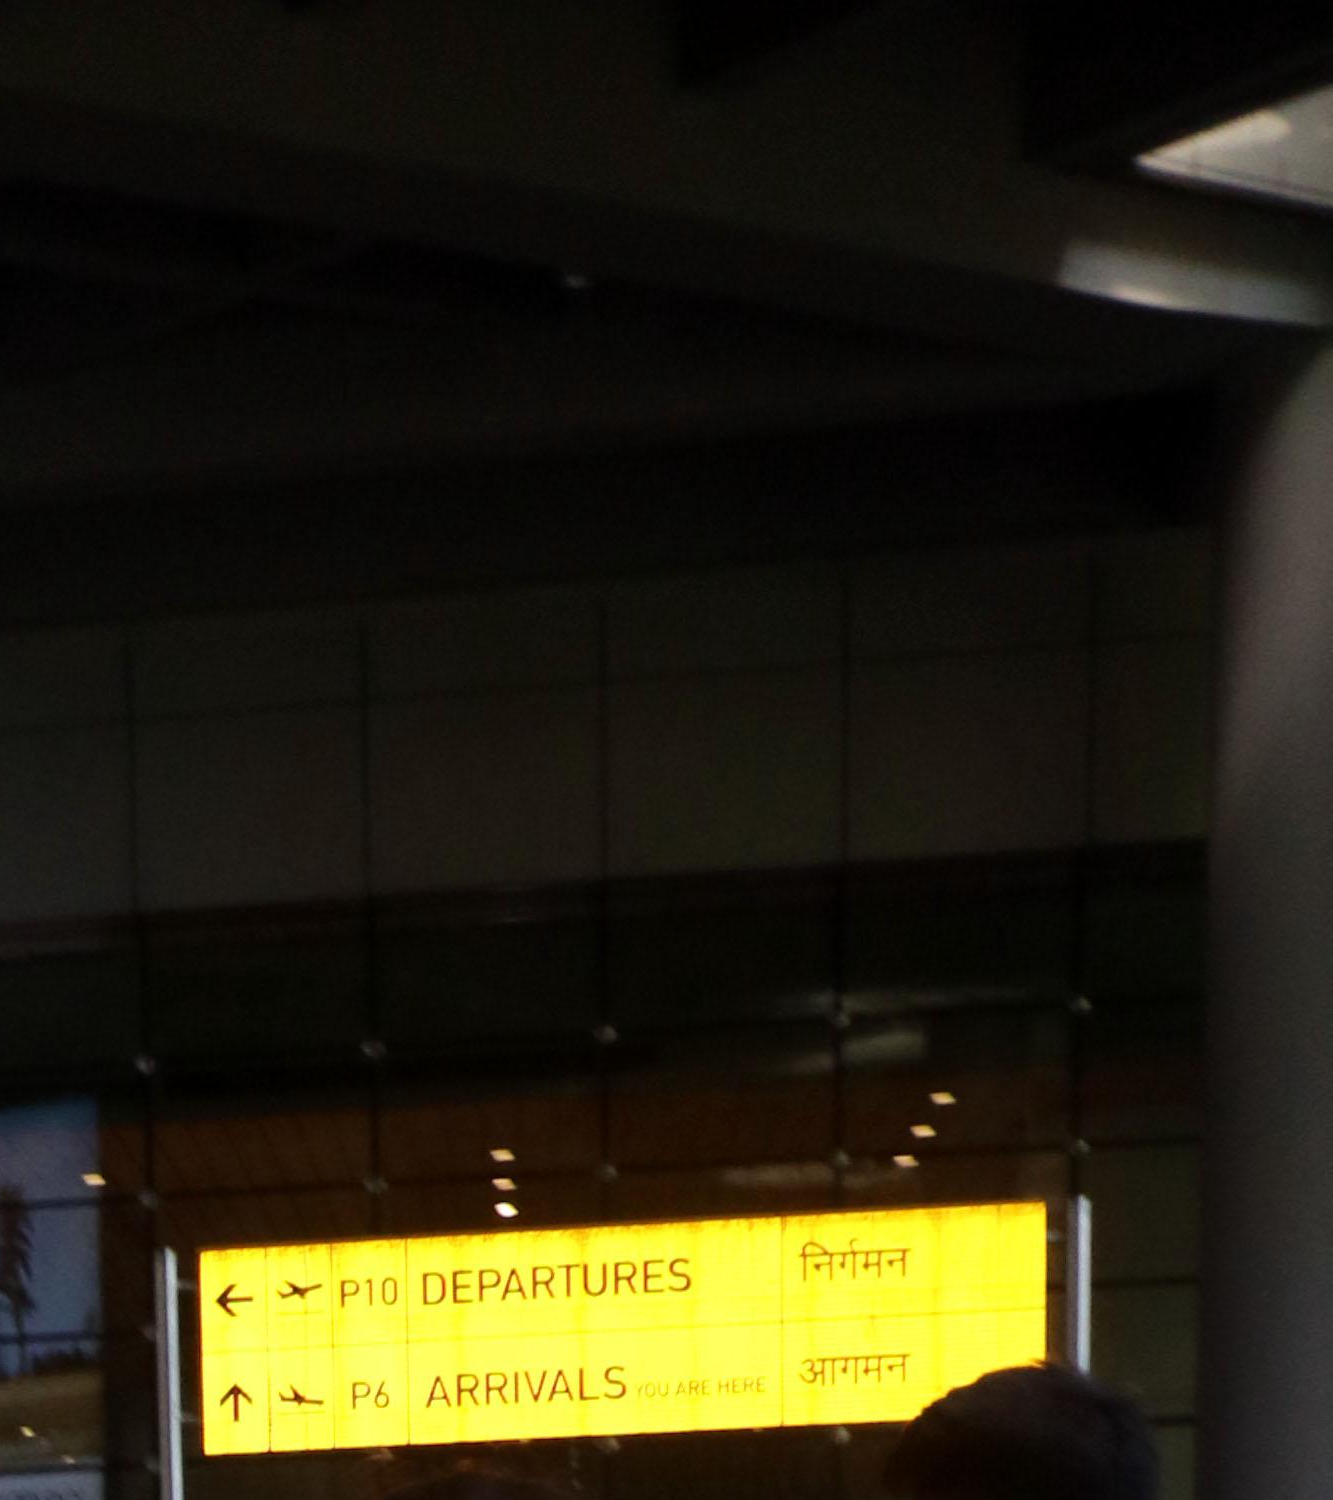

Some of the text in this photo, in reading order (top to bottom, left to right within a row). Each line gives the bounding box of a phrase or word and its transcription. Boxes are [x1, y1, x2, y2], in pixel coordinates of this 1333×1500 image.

[339, 1257, 694, 1309] P10 DEPARTURES
[798, 1238, 912, 1283] निर्गमन
[351, 1365, 768, 1411] P6 ARRIVALS YOU ARE HERE
[798, 1352, 912, 1387] आगमन
